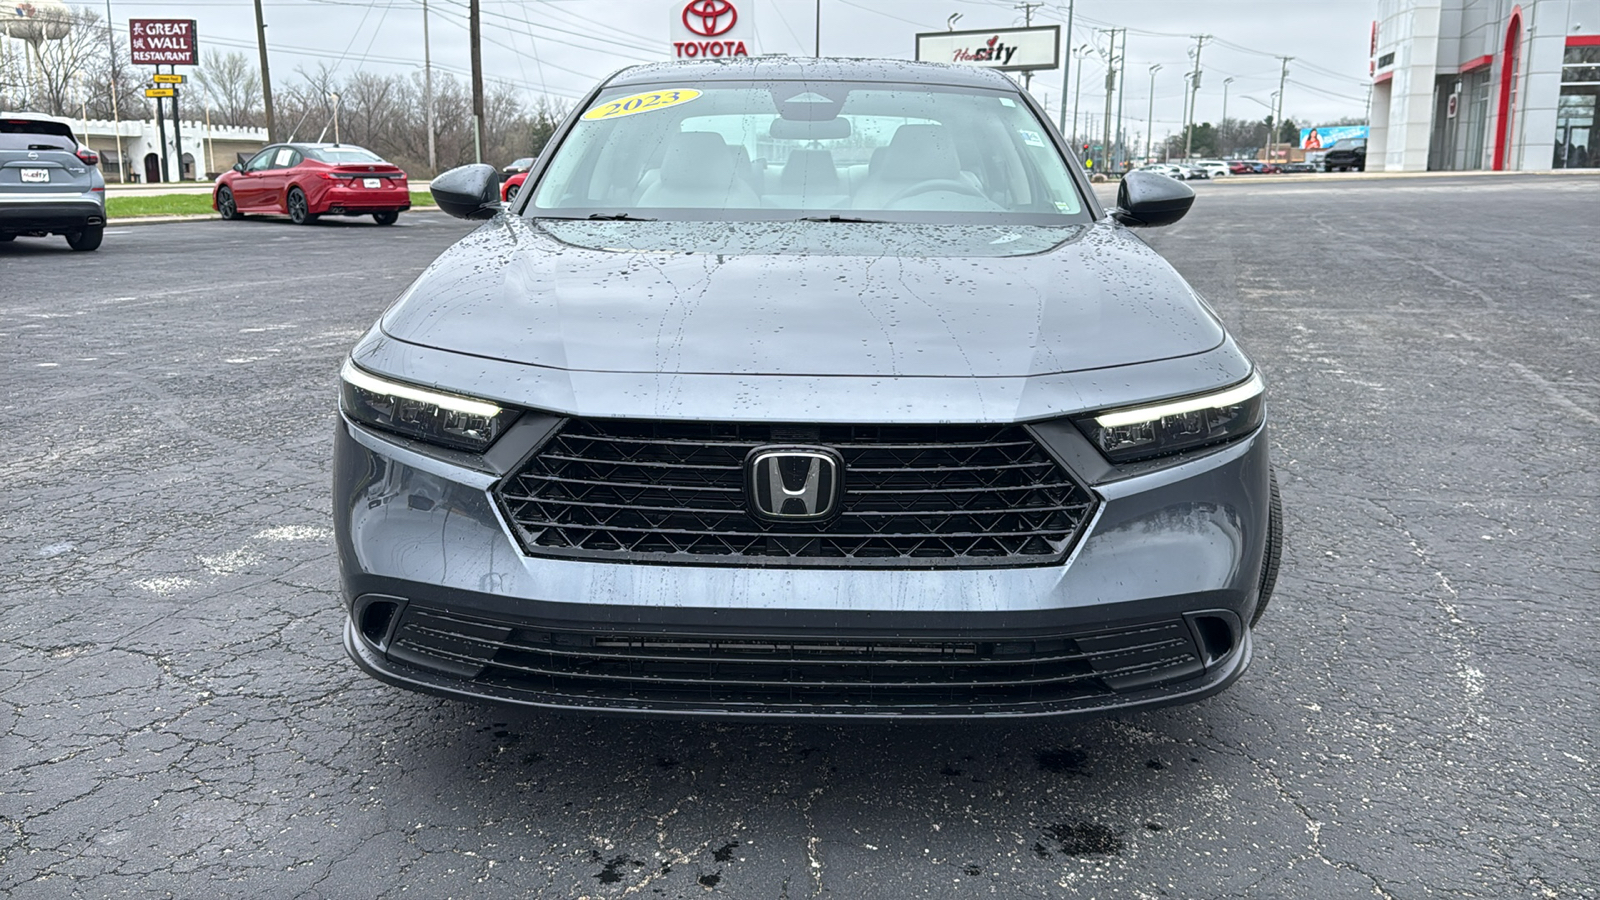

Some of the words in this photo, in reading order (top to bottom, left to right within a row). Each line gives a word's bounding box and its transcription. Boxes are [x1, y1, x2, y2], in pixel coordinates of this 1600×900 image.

[146, 23, 188, 35] GREAT
[147, 37, 188, 49] WALL
[673, 41, 748, 58] TOYOTA
[132, 52, 191, 61] RESTAURANT
[602, 91, 681, 117] 2023
